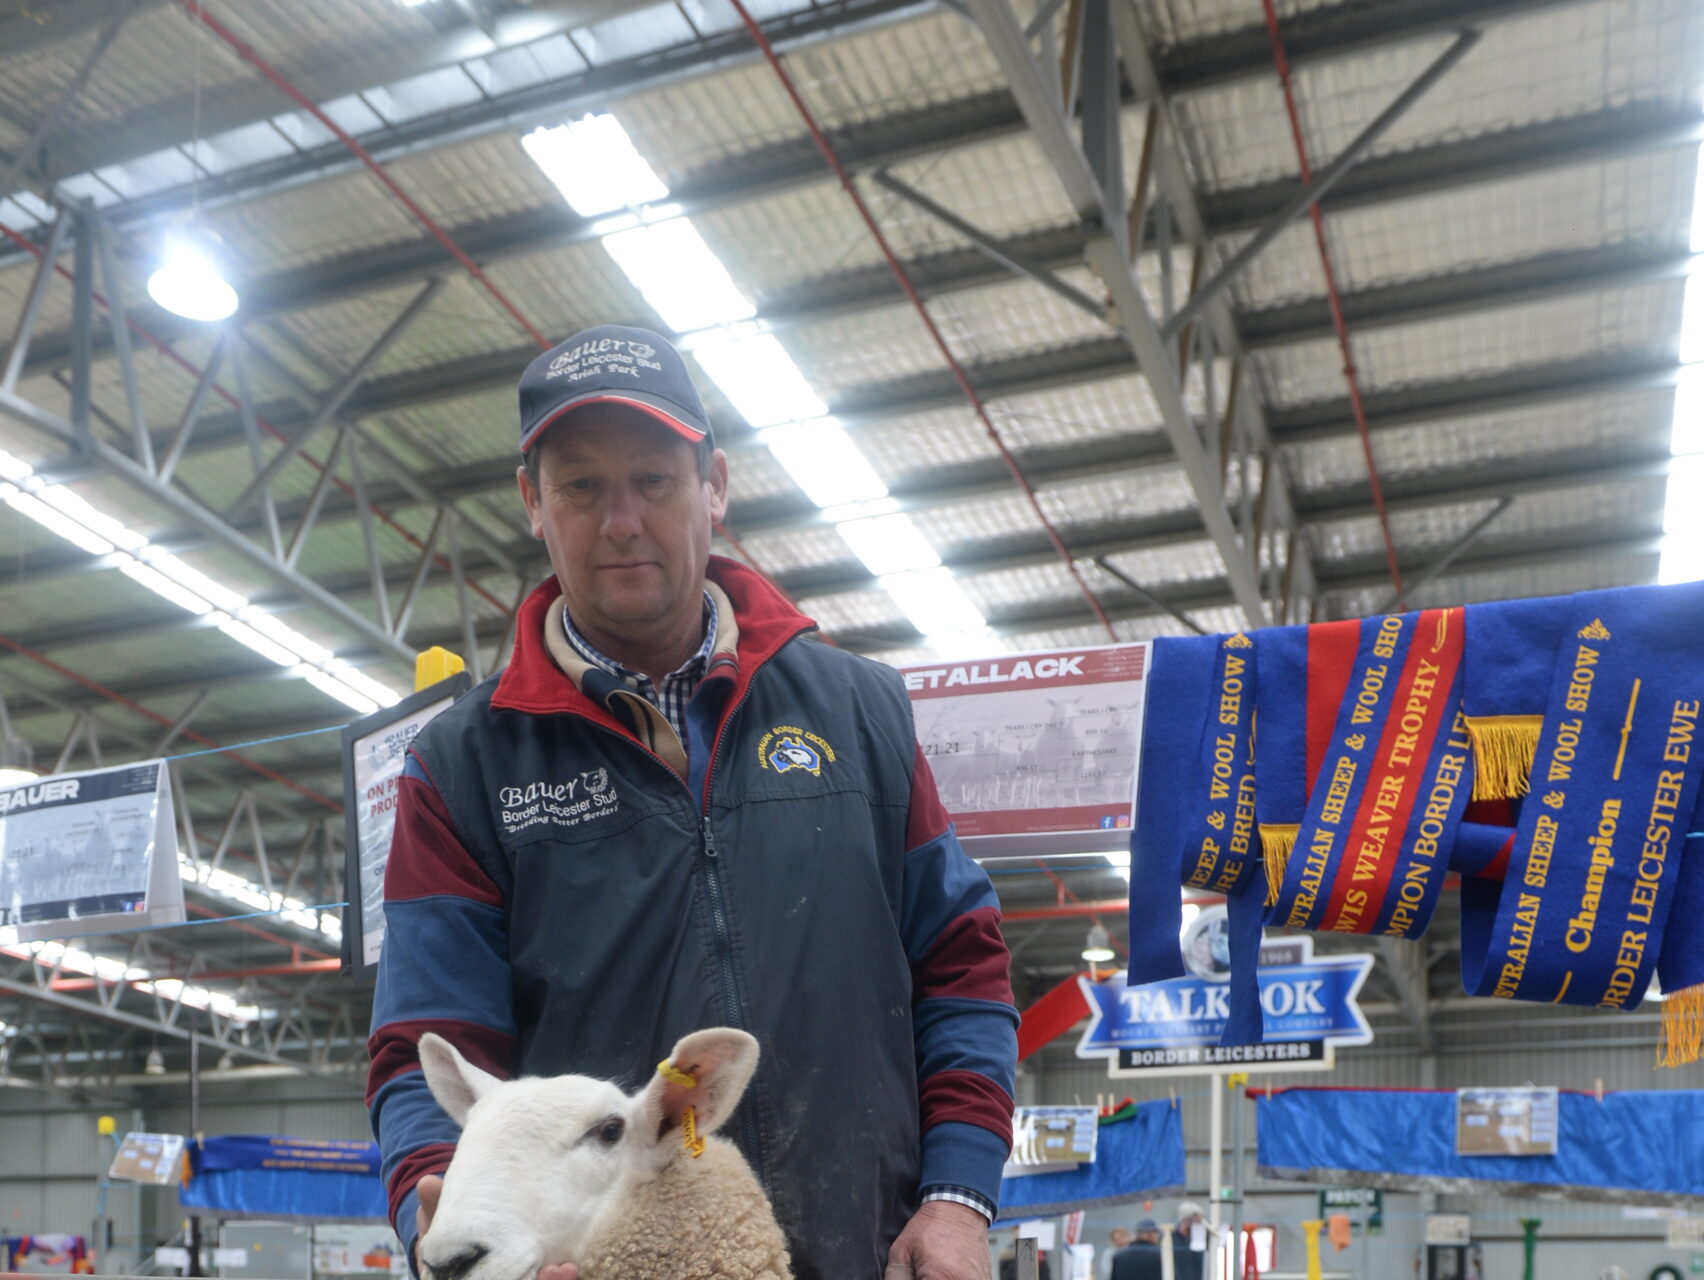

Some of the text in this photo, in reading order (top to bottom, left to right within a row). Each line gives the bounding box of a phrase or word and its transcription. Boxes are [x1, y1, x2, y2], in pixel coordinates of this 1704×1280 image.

[549, 338, 626, 370] Bauer
[607, 363, 640, 378] Park
[903, 656, 1086, 690] ETALLACK
[1219, 654, 1246, 725] SHOW
[367, 782, 384, 800] ON
[499, 778, 578, 808] Bauer
[1210, 732, 1236, 800] WOOL
[1286, 615, 1403, 928] STRALIAN SHEEP & WOOL SHO
[1353, 776, 1405, 881] WEAVER
[1389, 658, 1440, 768] TROPHY
[502, 786, 617, 823] Border Leicester Stud
[1207, 810, 1225, 830] &
[1230, 774, 1256, 855] BREED
[1413, 754, 1465, 858] BORDER
[1494, 645, 1600, 997] STRALIAN SHEEP & WOOL SHOW
[1627, 770, 1685, 924] LEICESTER
[1663, 700, 1700, 764] EWE
[1565, 799, 1622, 953] Champion
[1120, 979, 1327, 1024] TALKOK
[1131, 1043, 1311, 1066] BORDER LEICESTERS
